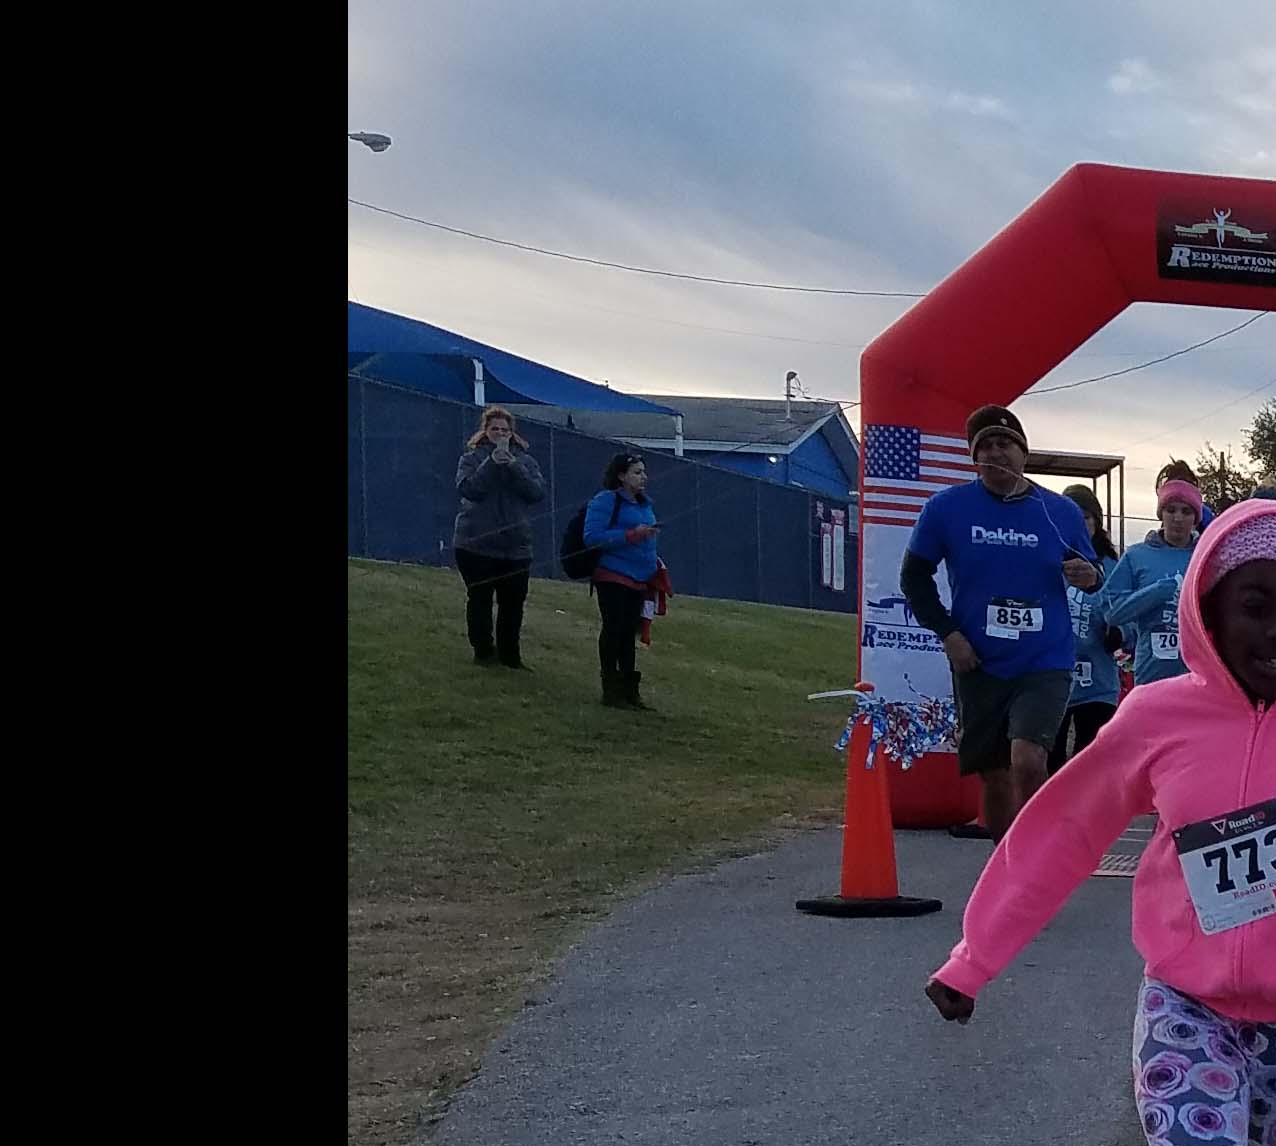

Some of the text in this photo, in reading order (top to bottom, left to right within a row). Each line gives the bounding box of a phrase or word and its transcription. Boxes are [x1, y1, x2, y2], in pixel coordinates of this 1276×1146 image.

[1167, 247, 1276, 268] REDEMPTION
[971, 525, 1039, 548] Dakine
[996, 608, 1034, 627] 854
[1079, 603, 1093, 639] POLAR
[898, 642, 945, 653] Produc
